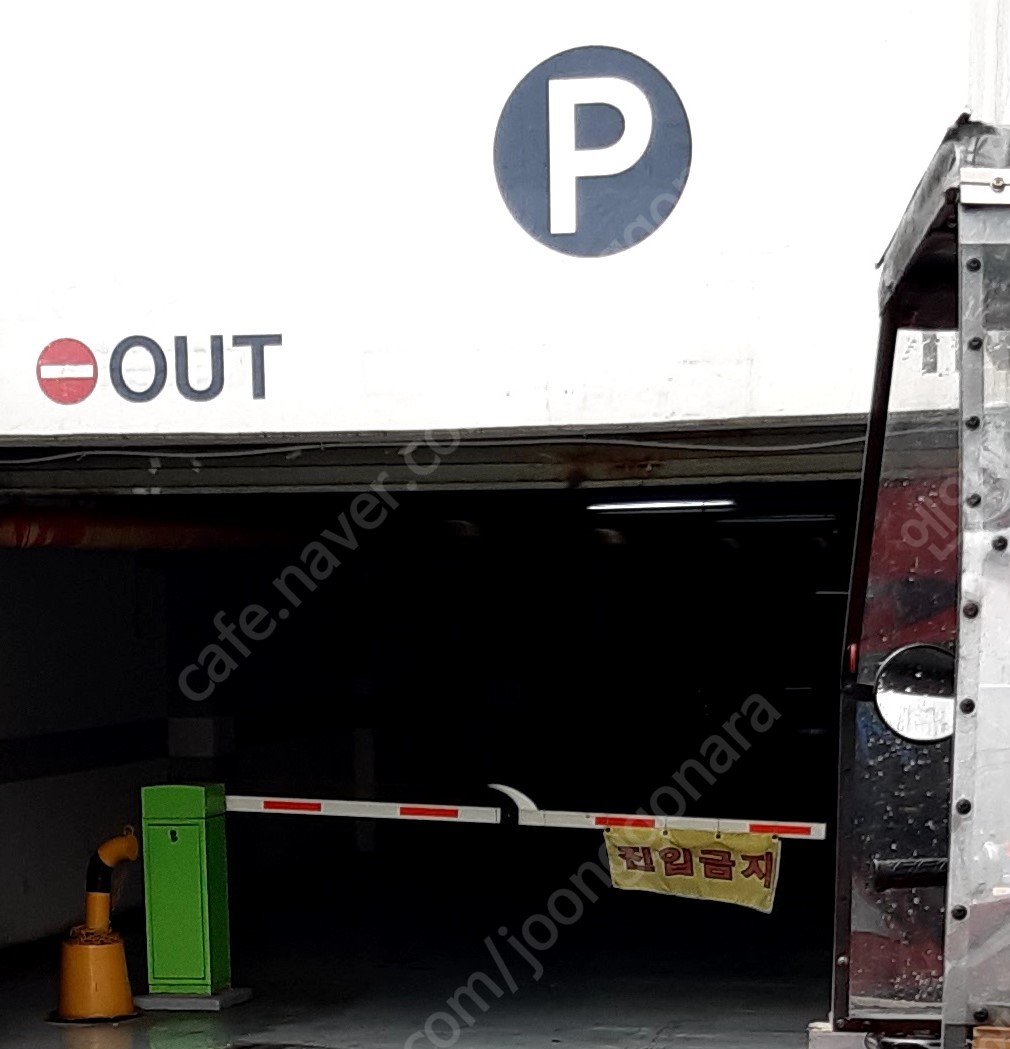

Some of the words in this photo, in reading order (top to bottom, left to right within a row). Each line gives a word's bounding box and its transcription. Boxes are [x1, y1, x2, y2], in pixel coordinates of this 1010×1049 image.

[548, 76, 653, 235] P
[109, 333, 283, 404] OUT
[617, 845, 773, 889] 진입금지
